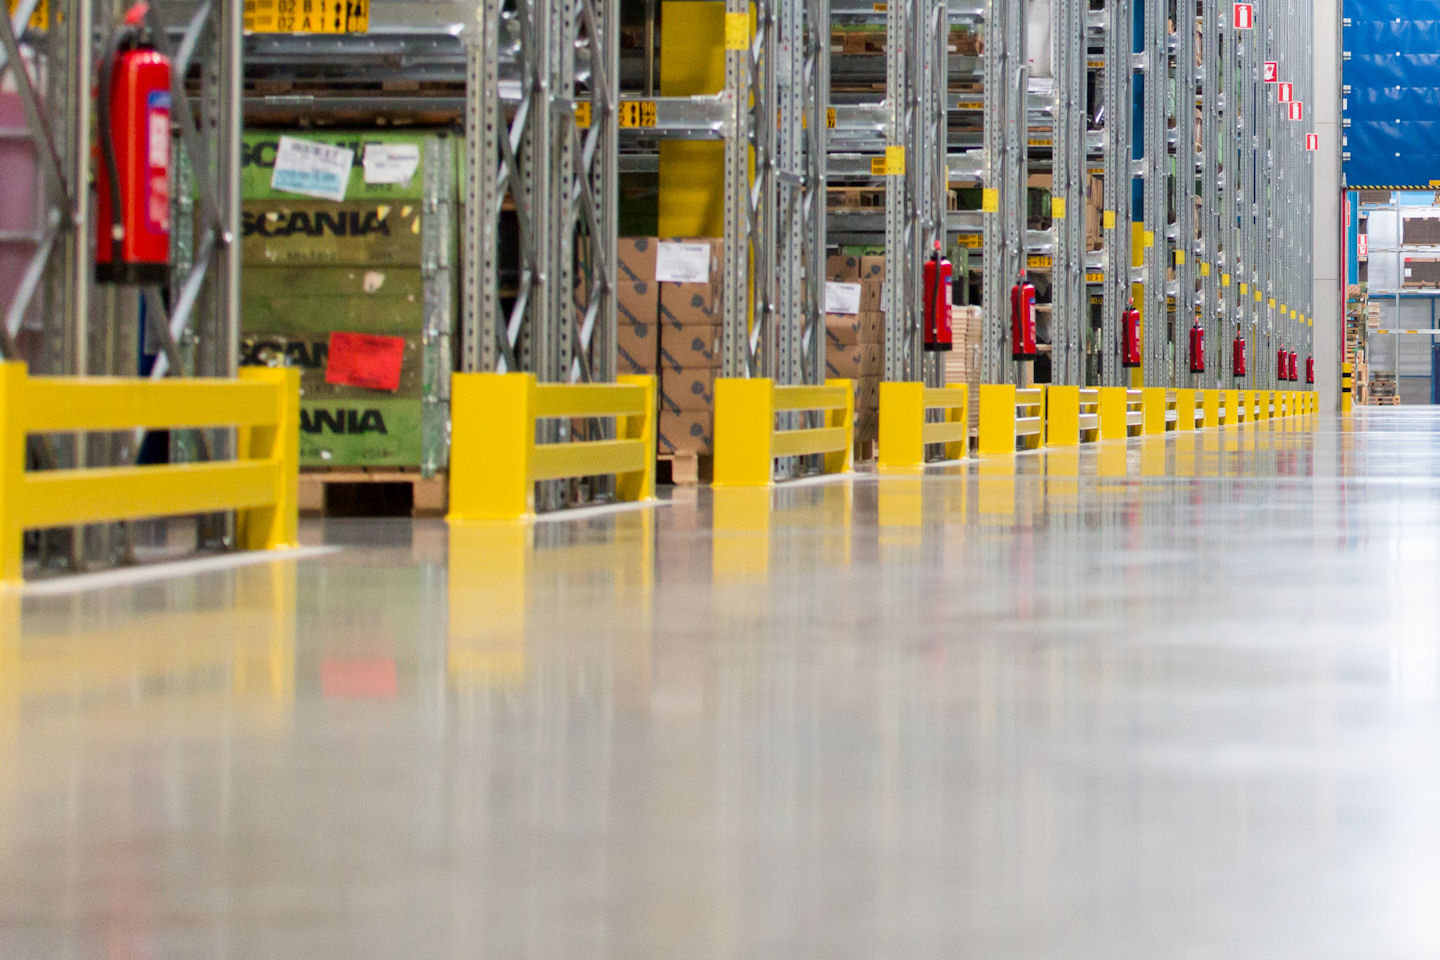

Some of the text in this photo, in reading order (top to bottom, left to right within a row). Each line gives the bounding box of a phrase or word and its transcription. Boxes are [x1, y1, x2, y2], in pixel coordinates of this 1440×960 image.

[278, 0, 296, 14] 02
[278, 16, 296, 30] 02
[241, 211, 391, 236] SCANIA
[240, 342, 330, 368] SCAN
[301, 409, 388, 434] ANIA
